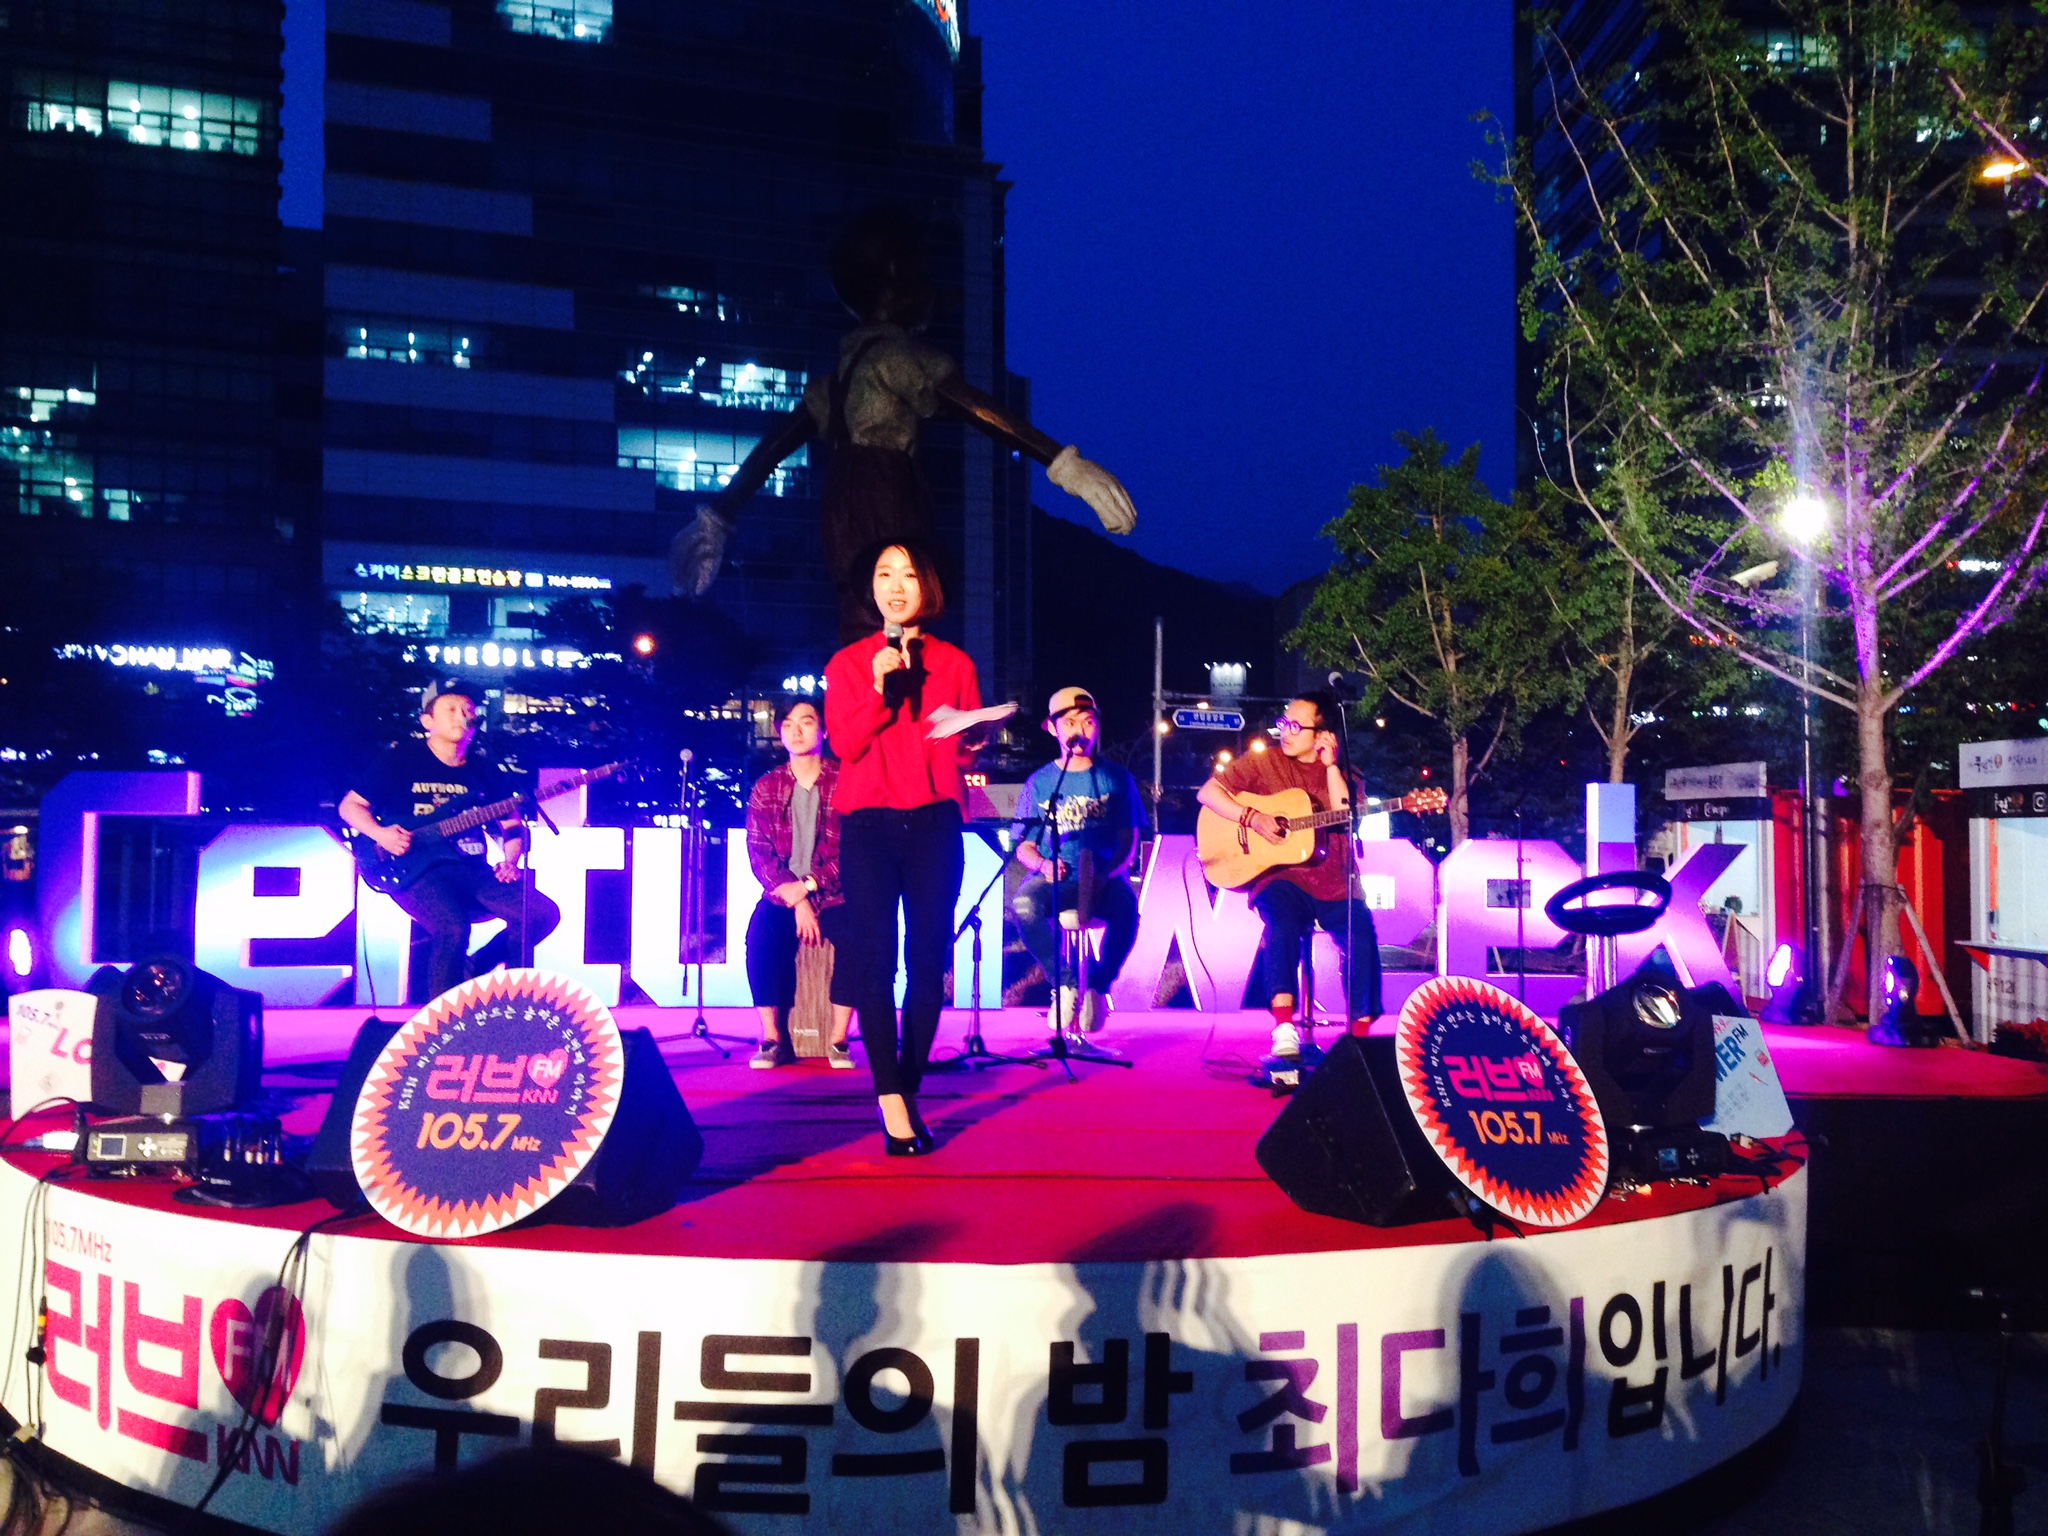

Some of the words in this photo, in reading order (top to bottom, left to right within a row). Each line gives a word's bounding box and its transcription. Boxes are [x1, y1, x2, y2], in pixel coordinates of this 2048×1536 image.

[425, 1054, 529, 1103] 러브
[531, 1058, 563, 1080] FM
[1442, 1054, 1528, 1102] 러브
[1517, 1061, 1543, 1081] FM
[522, 1088, 559, 1104] KNN
[1526, 1088, 1556, 1102] KNN
[416, 1112, 522, 1150] 105.7
[1467, 1109, 1543, 1146] 105.7
[45, 1257, 209, 1464] 러브
[380, 1318, 979, 1515] 우리들의
[1047, 1331, 1194, 1509] 밤
